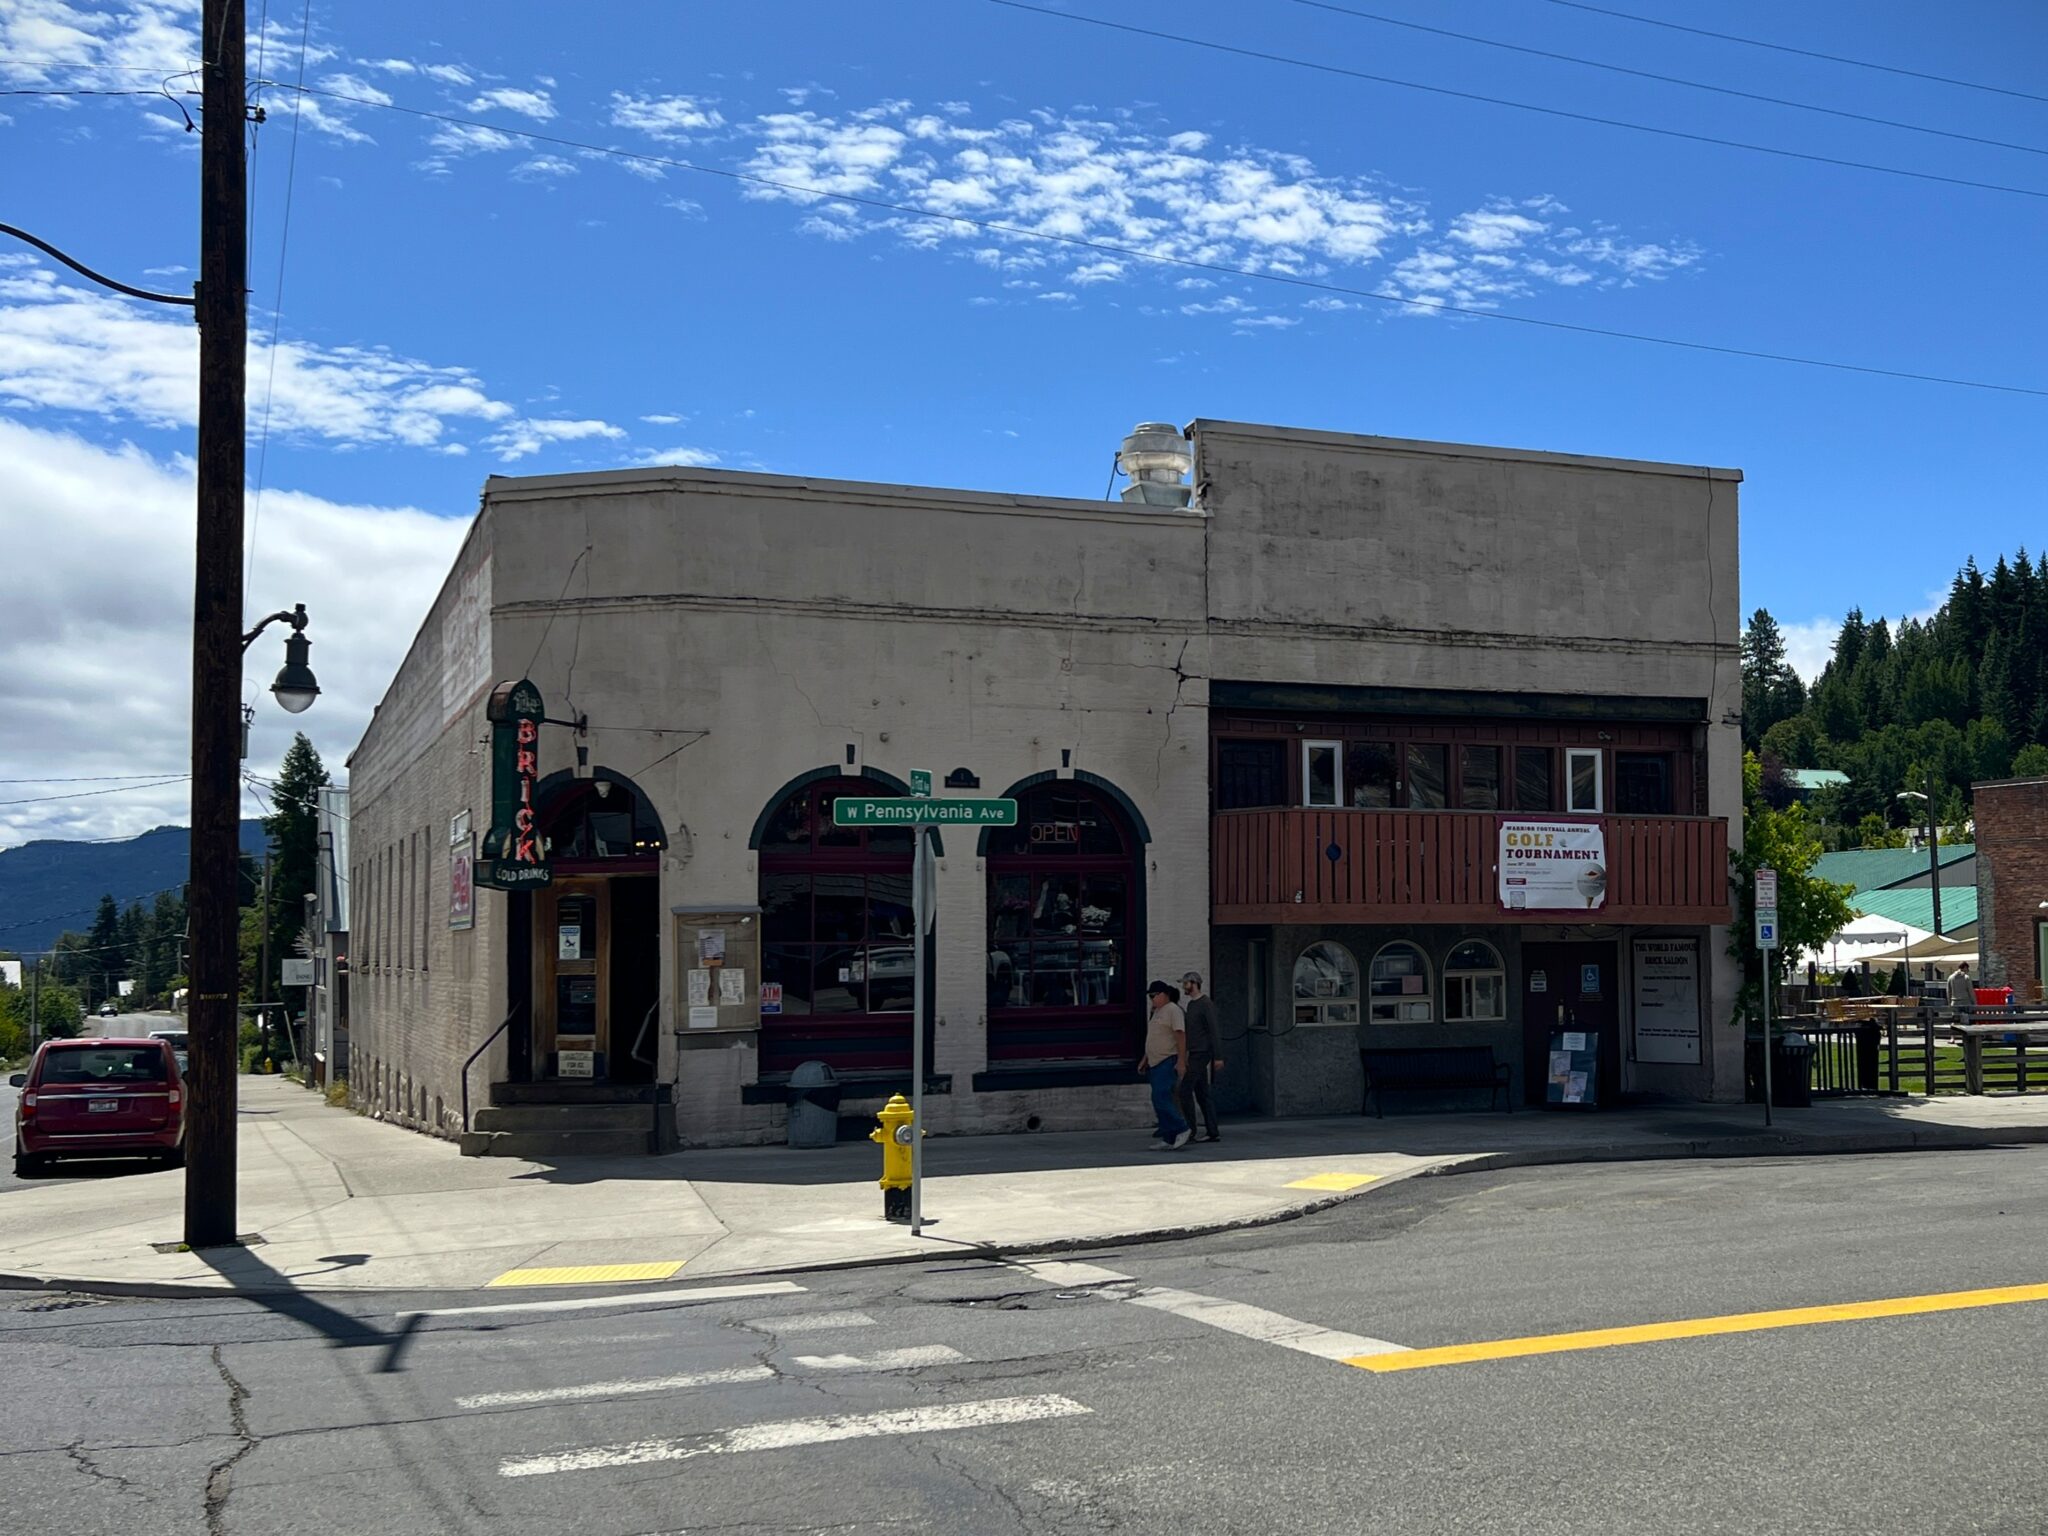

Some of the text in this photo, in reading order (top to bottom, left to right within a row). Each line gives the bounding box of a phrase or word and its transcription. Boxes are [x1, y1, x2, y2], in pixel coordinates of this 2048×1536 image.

[515, 718, 538, 865] BRICK
[847, 804, 1004, 822] W Pennsylvania Ave
[1030, 824, 1079, 841] OPEN
[1506, 832, 1554, 847] GOLF
[1505, 849, 1600, 860] TOURNAMENT
[518, 867, 549, 881] DRINKS
[1663, 956, 1689, 965] SALOON
[762, 986, 780, 1000] ATM
